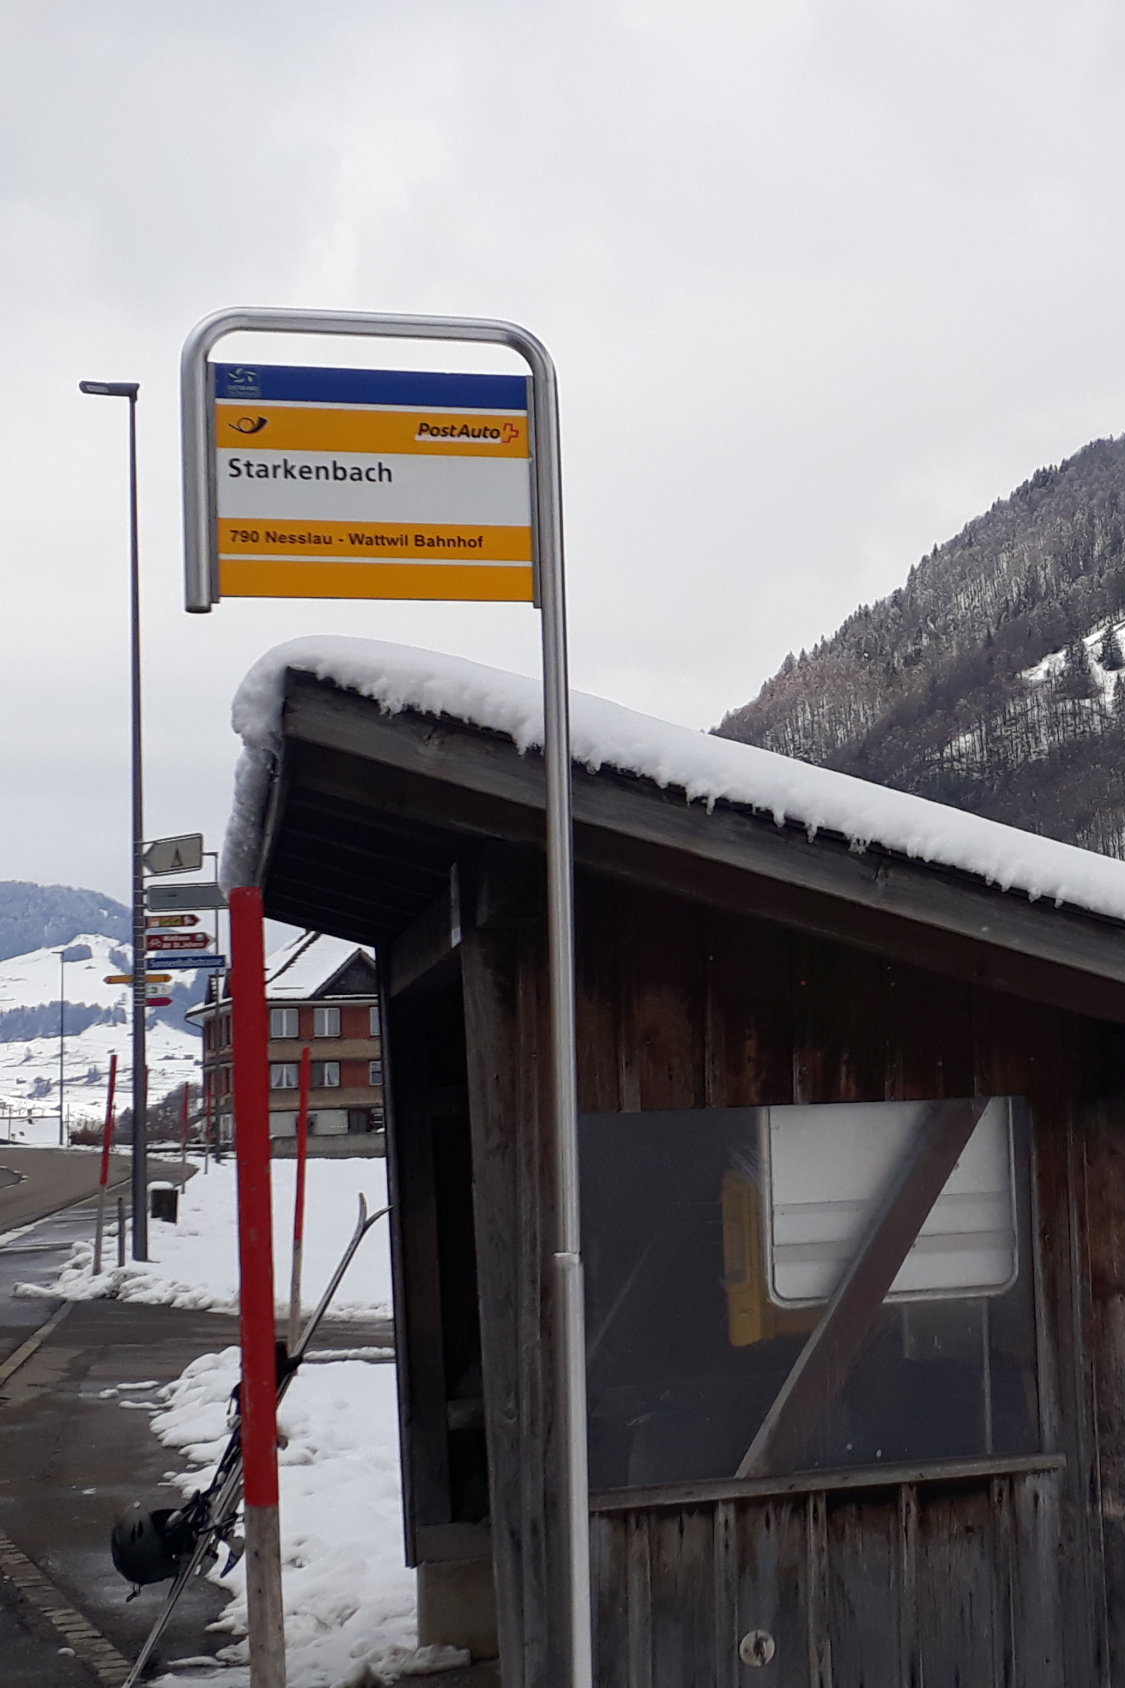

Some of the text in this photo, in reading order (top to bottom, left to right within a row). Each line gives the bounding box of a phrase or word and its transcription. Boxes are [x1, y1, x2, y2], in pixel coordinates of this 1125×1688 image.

[418, 422, 501, 439] PostAuto
[228, 457, 393, 483] Starkenbach
[229, 529, 260, 543] 790
[264, 530, 333, 545] Nesslau
[348, 532, 408, 547] Wattwil
[413, 534, 483, 548] Bahnhof
